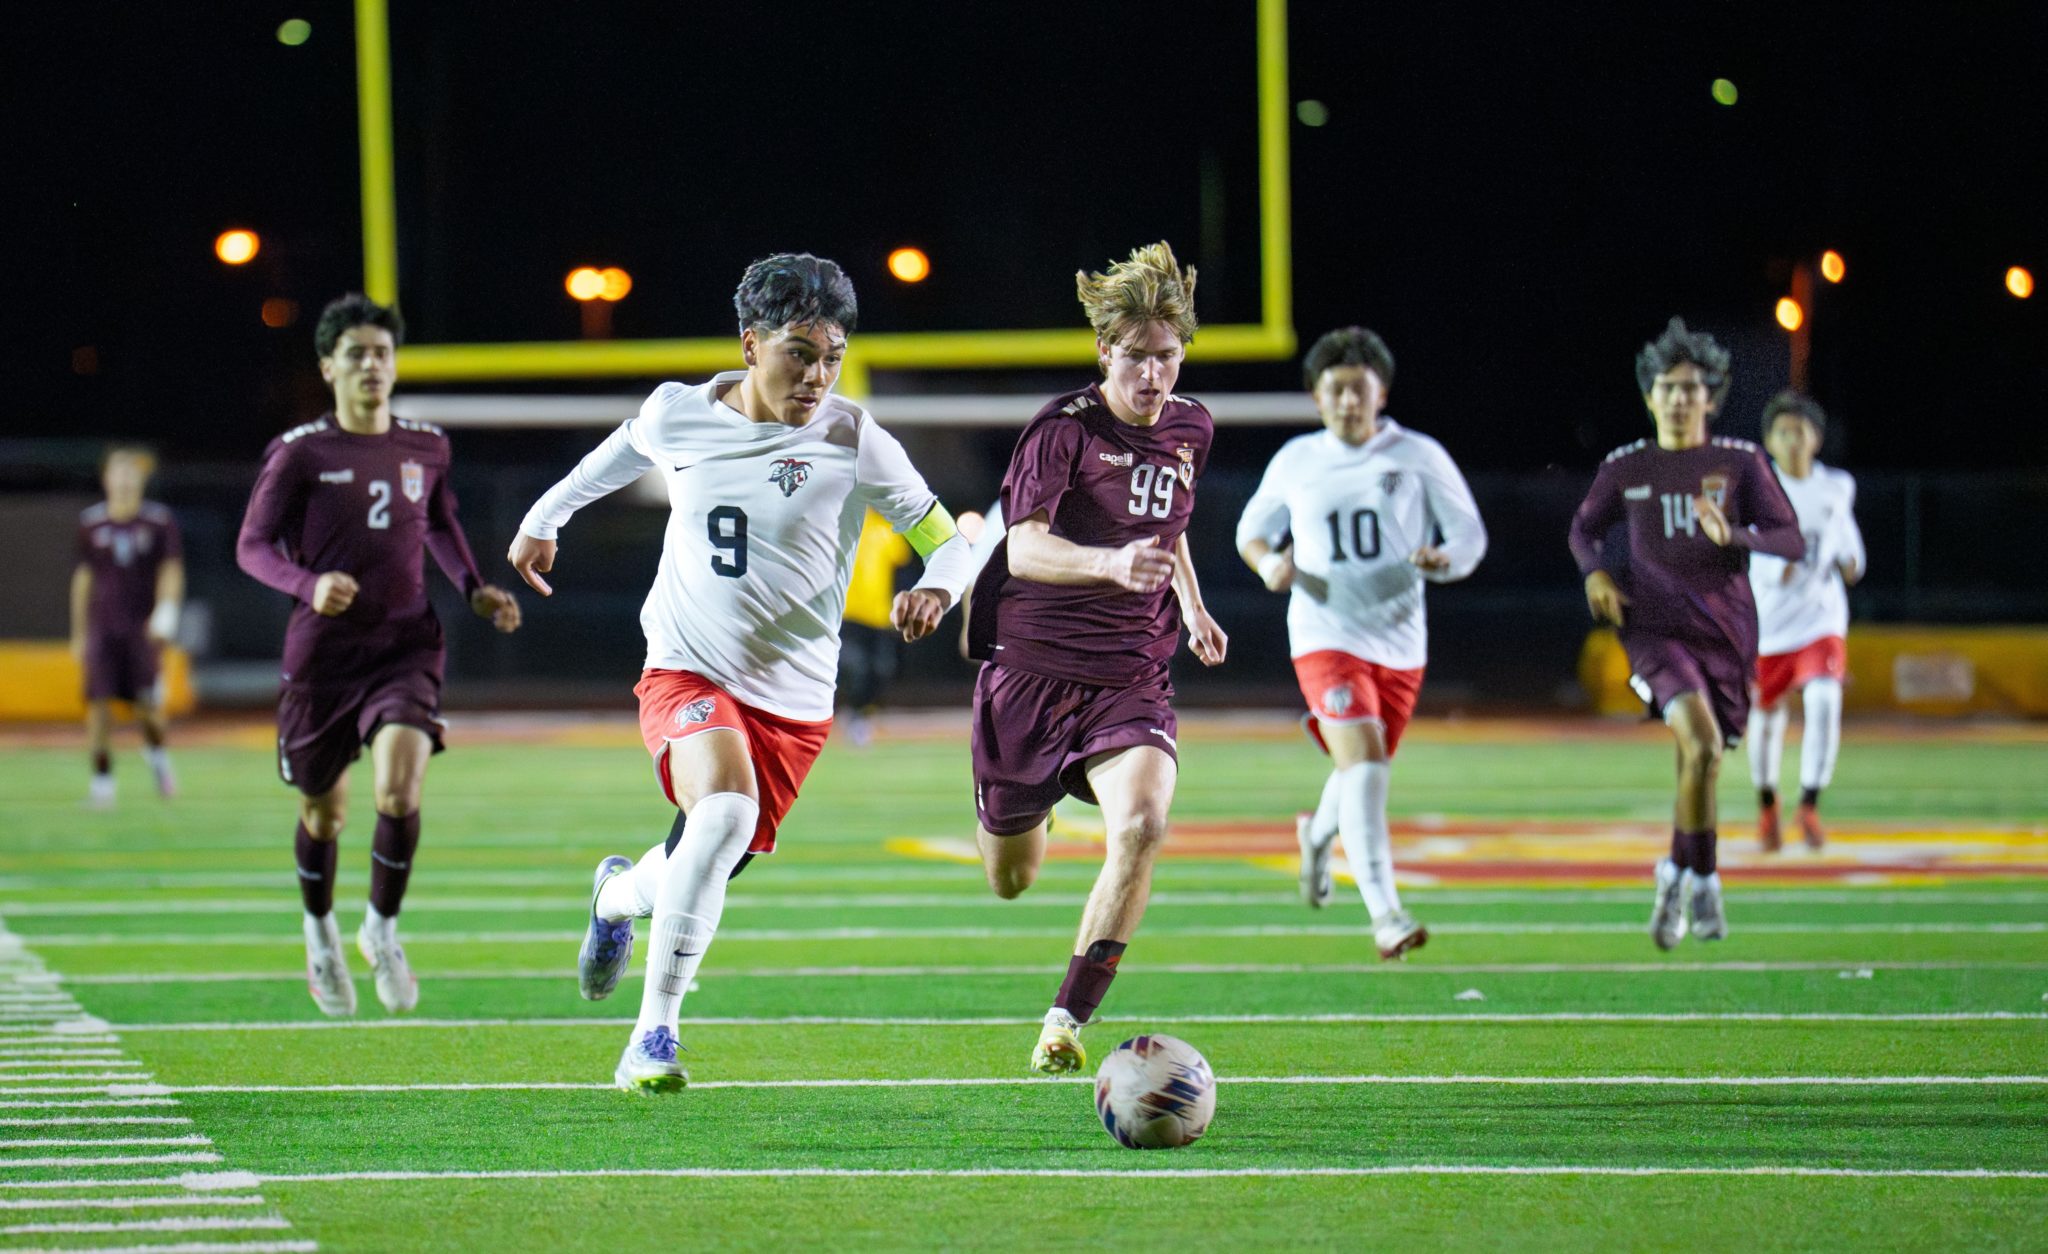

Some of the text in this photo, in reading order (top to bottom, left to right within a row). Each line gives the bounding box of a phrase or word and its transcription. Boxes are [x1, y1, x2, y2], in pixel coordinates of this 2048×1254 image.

[367, 480, 391, 529] 2
[1128, 463, 1177, 519] 99
[1660, 493, 1699, 539] 14
[707, 505, 748, 578] 9
[1326, 509, 1381, 561] 10
